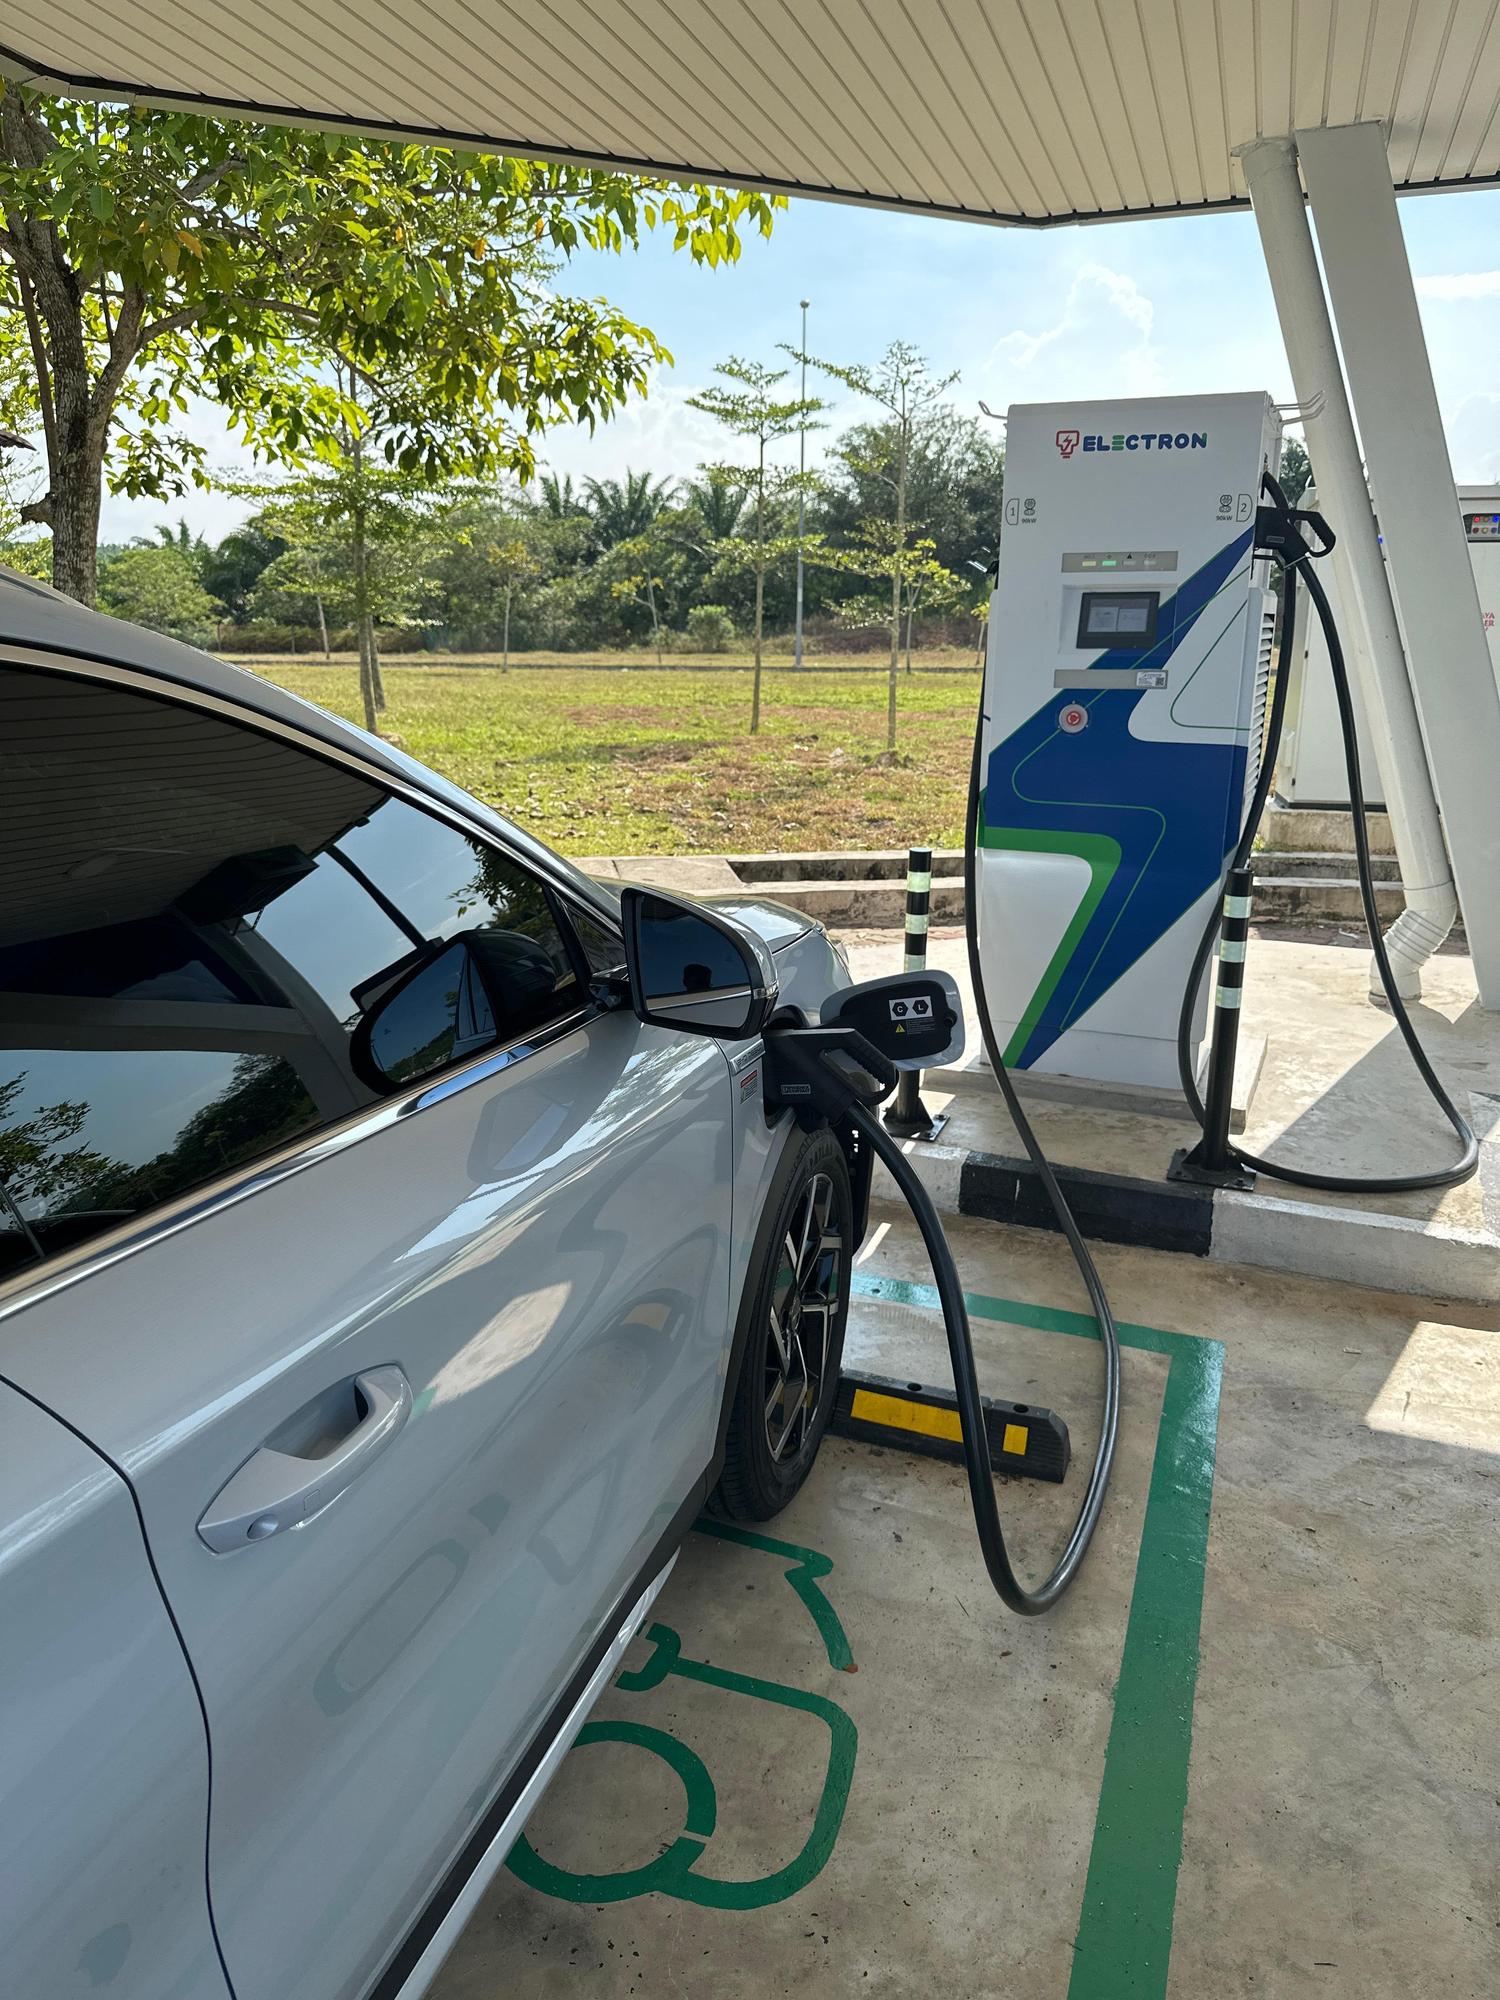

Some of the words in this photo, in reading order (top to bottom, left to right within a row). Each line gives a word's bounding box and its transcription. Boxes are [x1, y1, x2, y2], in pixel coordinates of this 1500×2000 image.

[1082, 432, 1208, 452] ELECTRON
[1010, 506, 1016, 516] 1
[1240, 502, 1247, 513] 2
[896, 1005, 904, 1013] C
